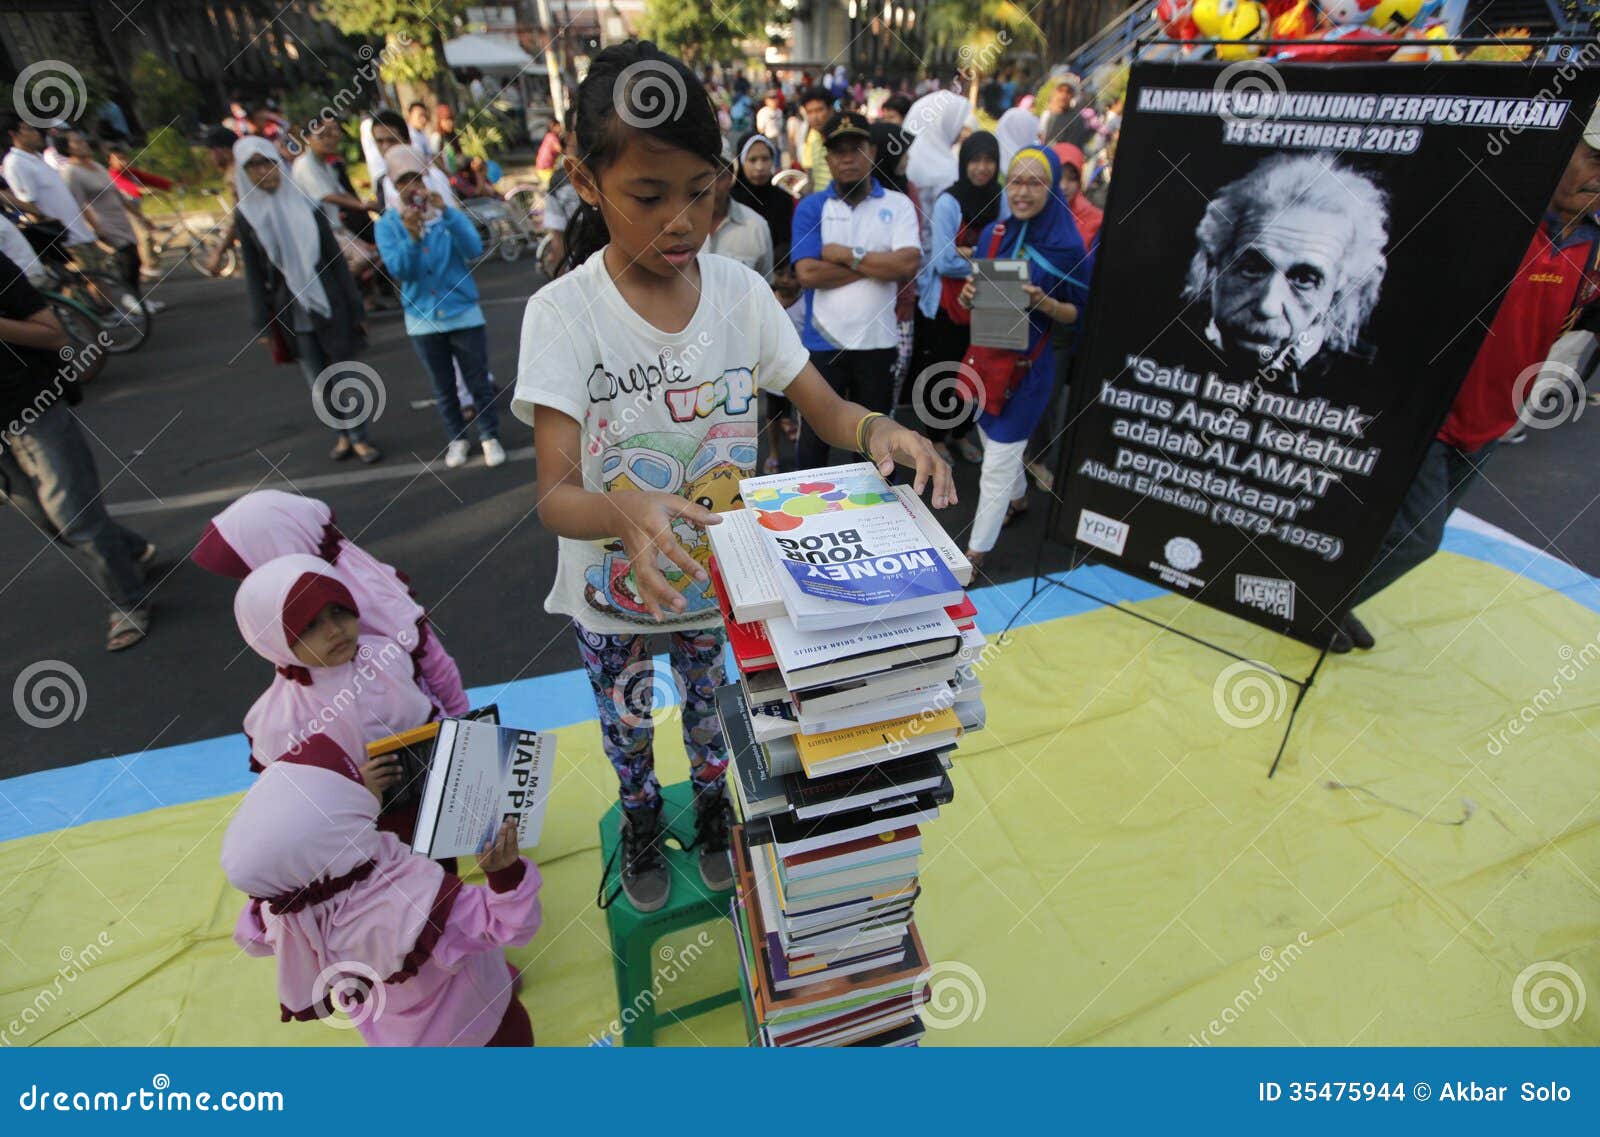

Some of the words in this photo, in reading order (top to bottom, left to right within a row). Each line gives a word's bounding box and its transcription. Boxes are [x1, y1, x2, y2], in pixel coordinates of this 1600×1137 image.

[1139, 88, 1232, 112] KAMPANYE
[1281, 94, 1376, 120] KUNJUNG
[1376, 97, 1568, 127] PERPUSTAKAAN
[1225, 121, 1247, 143] 14
[1248, 122, 1361, 149] SEPTEMBER
[1361, 127, 1420, 151] 2013
[1203, 371, 1252, 405] hal
[1254, 392, 1368, 437] mutlak
[1100, 381, 1174, 418] harus
[1176, 402, 1251, 440] Anda
[1257, 420, 1380, 475] ketahui
[1112, 419, 1201, 456] adalah
[1203, 440, 1341, 496] ALAMAT
[1079, 461, 1131, 488] Albert
[1134, 477, 1208, 514] Einstein
[1210, 502, 1343, 561] (1879-1955)
[775, 528, 863, 550] BLOG
[781, 543, 876, 565] YOUR
[806, 550, 936, 582] MONEY
[866, 626, 914, 640] SODERBERG
[916, 621, 942, 631] NANCY
[503, 730, 537, 827] HAPPE
